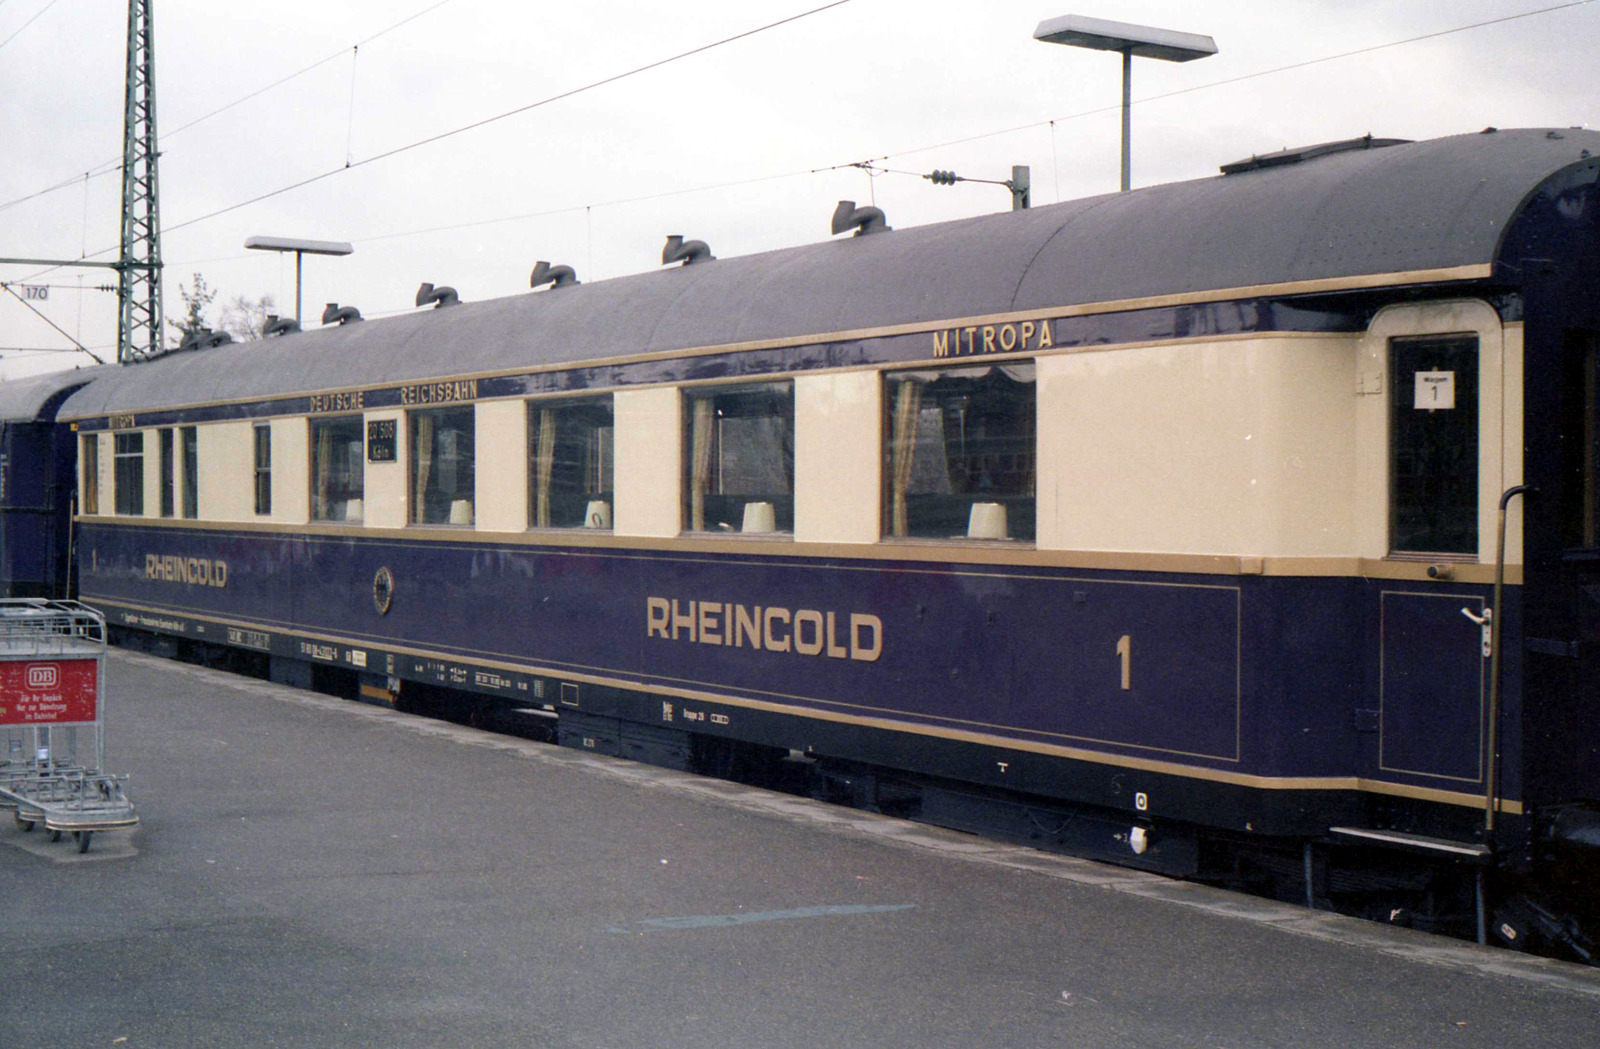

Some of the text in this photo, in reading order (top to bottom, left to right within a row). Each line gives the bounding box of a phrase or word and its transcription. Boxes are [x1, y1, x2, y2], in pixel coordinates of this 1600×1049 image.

[26, 287, 48, 300] 170
[933, 320, 1053, 357] MITROPA
[310, 379, 478, 412] DEUTSCHE REICHSBAHN
[1431, 385, 1438, 401] 1
[145, 554, 227, 588] RHEINGOLD
[647, 596, 882, 662] RHEINGOLD
[33, 670, 53, 682] DB
[1116, 635, 1131, 690] 1
